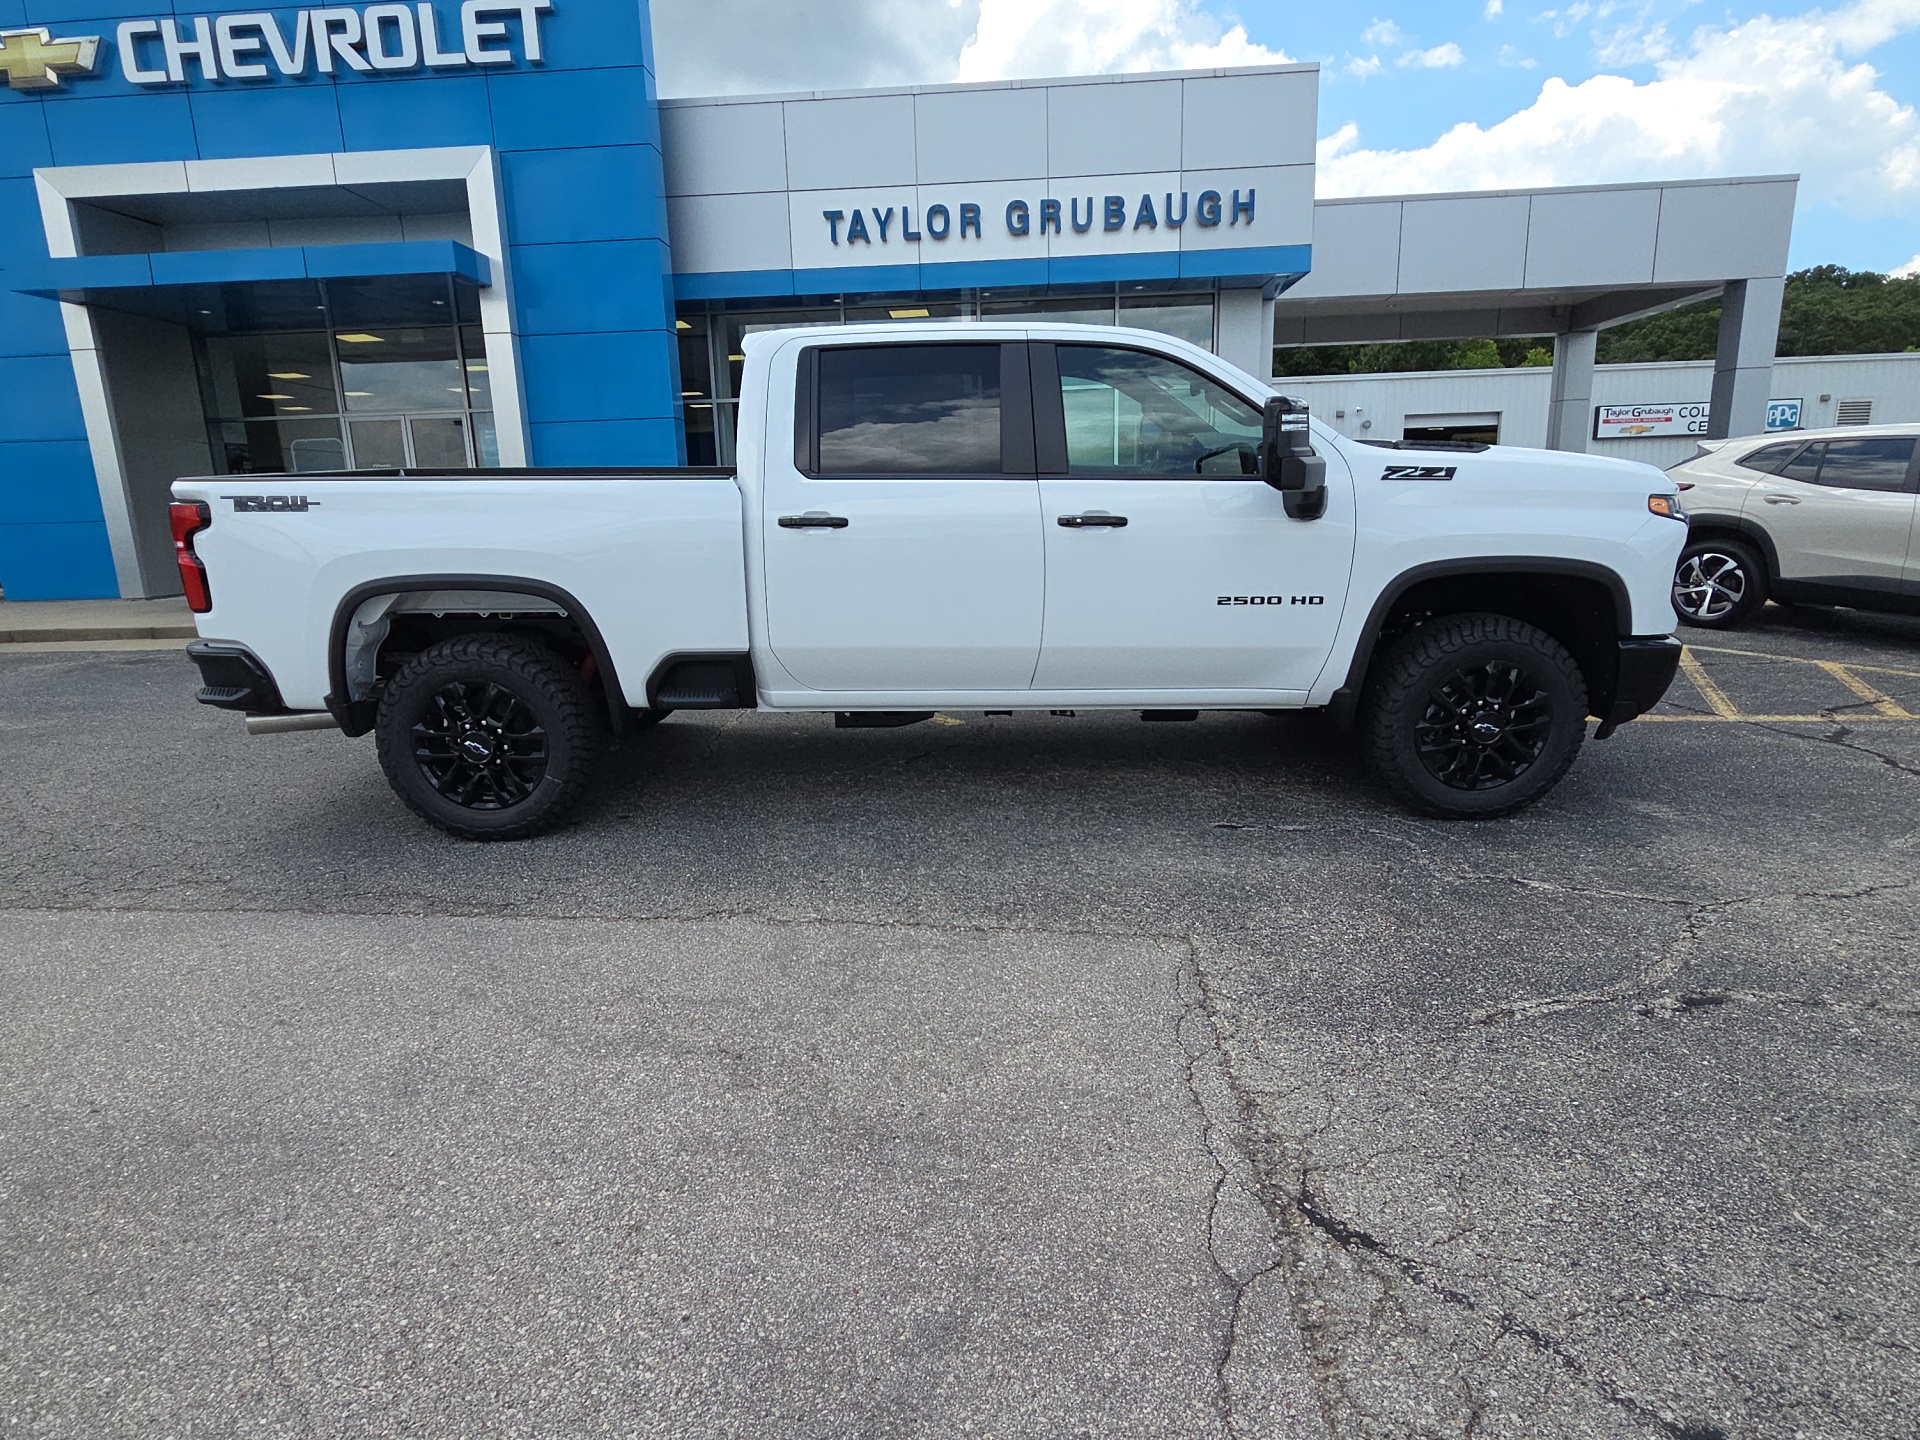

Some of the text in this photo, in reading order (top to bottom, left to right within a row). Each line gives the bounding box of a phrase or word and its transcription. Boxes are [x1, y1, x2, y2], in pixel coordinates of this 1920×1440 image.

[116, 0, 552, 85] CHEVROLET
[822, 188, 1257, 245] TAYLOR GRUBAUGH
[1603, 407, 1674, 418] Taylor Grubaugh
[1768, 406, 1798, 426] PPG
[1380, 466, 1457, 480] Z71
[1217, 596, 1324, 605] 2500 HD
